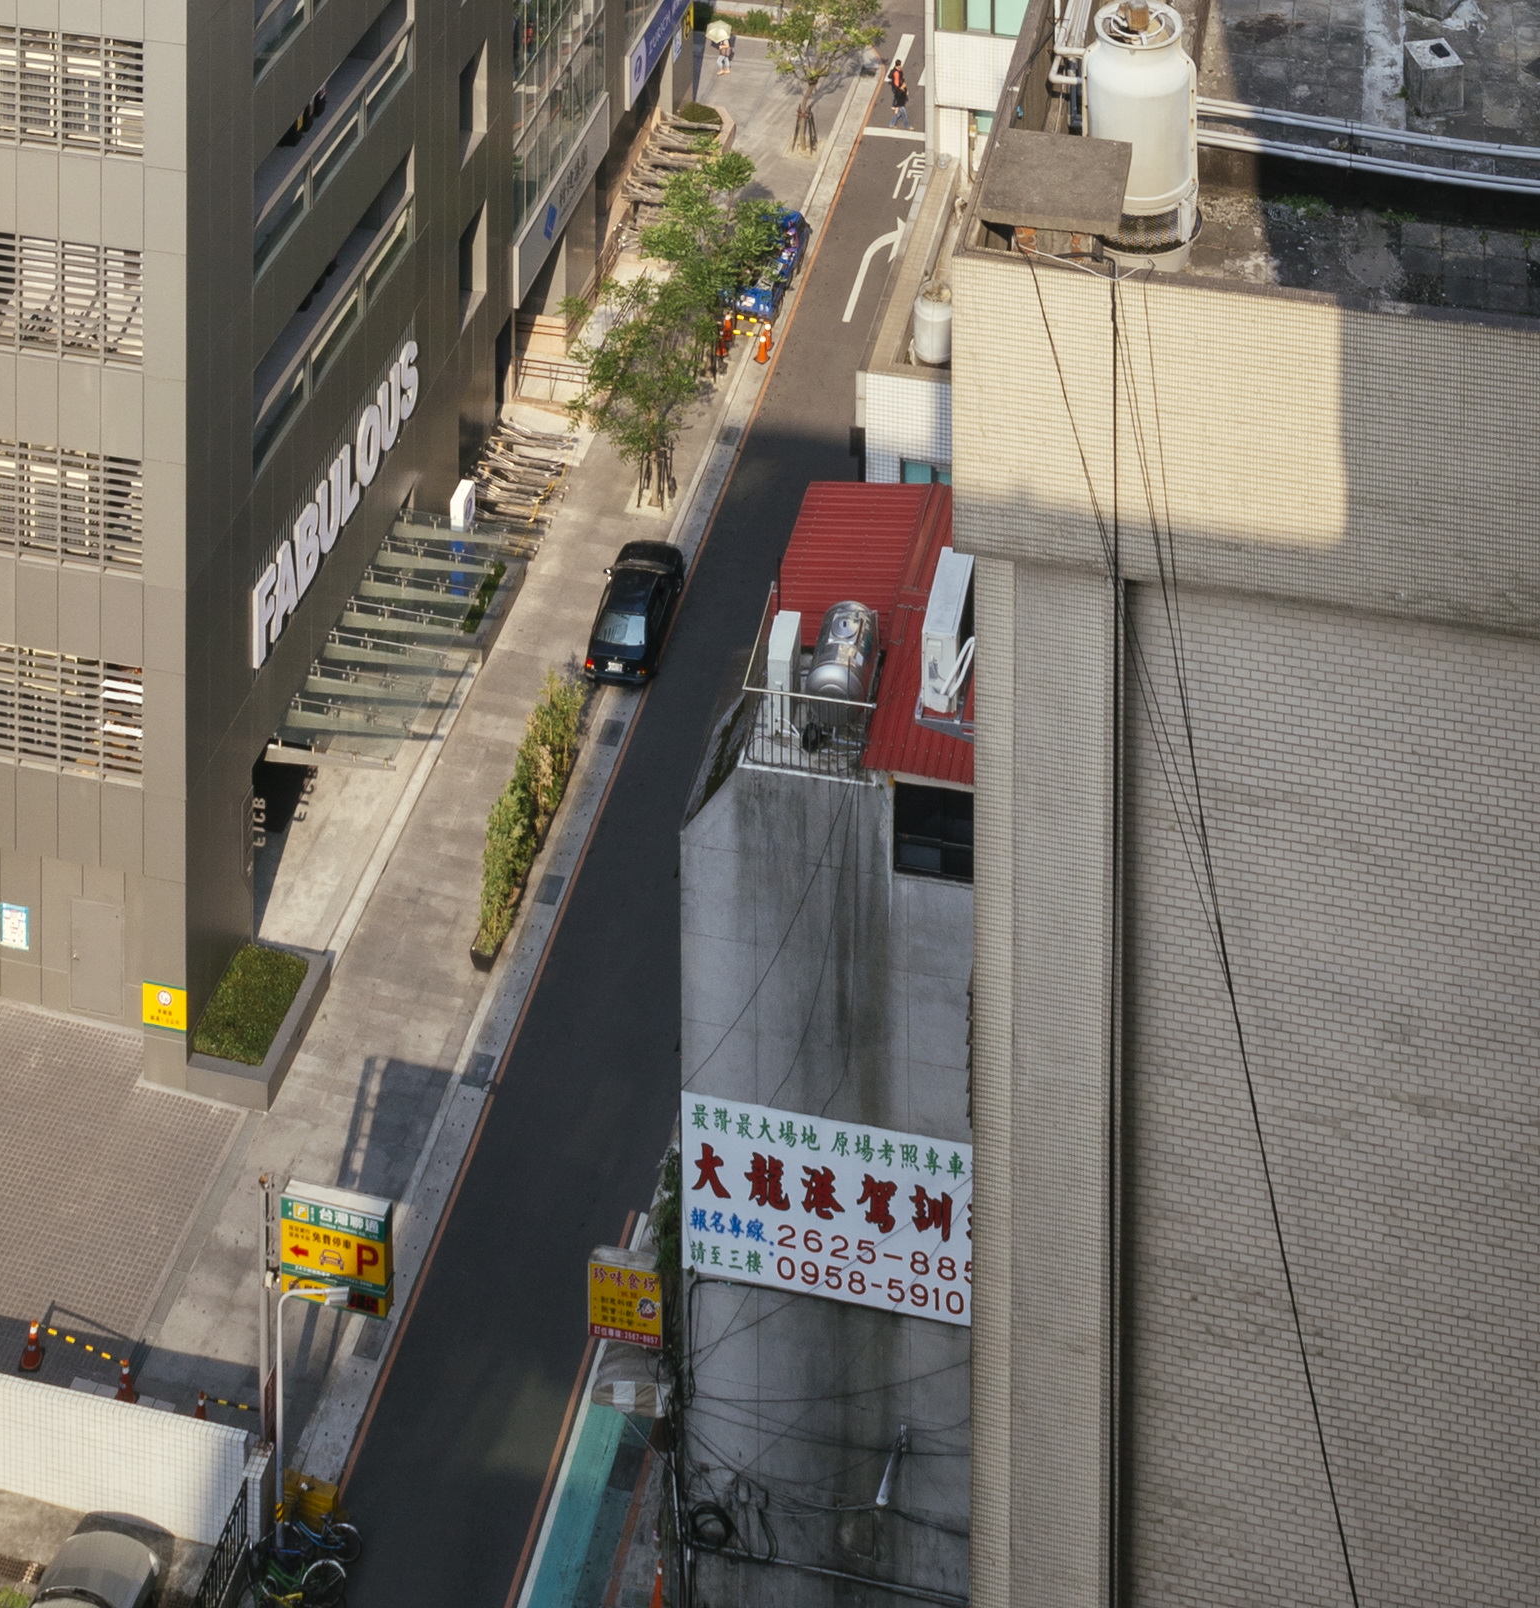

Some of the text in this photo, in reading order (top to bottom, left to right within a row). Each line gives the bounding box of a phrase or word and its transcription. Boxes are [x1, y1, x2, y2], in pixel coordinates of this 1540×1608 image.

[252, 339, 419, 669] FABULOUS
[830, 1131, 972, 1180] 原場考照專車
[691, 1142, 972, 1242] 大龍港駕訓
[319, 1207, 379, 1234] 台灣聯通
[312, 1232, 351, 1250] 免費停車
[690, 1240, 763, 1275] 請至三樓
[356, 1243, 379, 1276] P
[592, 1266, 657, 1293] 珍味食坊
[776, 1256, 965, 1315] 0958-5910
